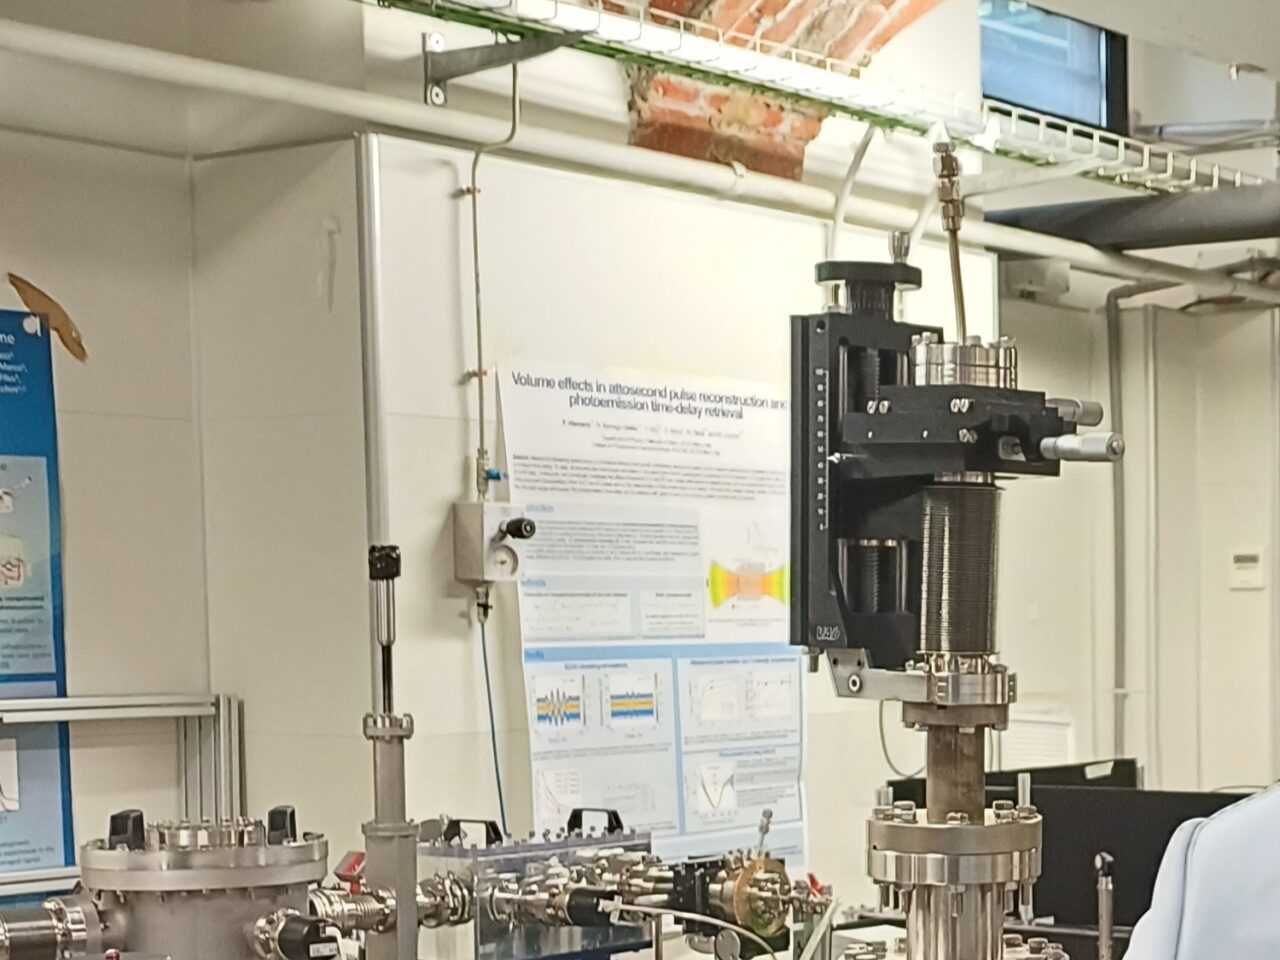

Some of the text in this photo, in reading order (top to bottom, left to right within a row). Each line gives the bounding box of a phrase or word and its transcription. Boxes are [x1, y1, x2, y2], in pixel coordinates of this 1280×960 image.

[511, 371, 556, 389] Volume
[558, 377, 594, 393] effects
[596, 379, 607, 394] in
[608, 382, 667, 400] attosecond
[669, 387, 697, 403] pulse
[699, 391, 769, 409] reconstruction
[568, 391, 743, 420] photoemission time-delay retrieval
